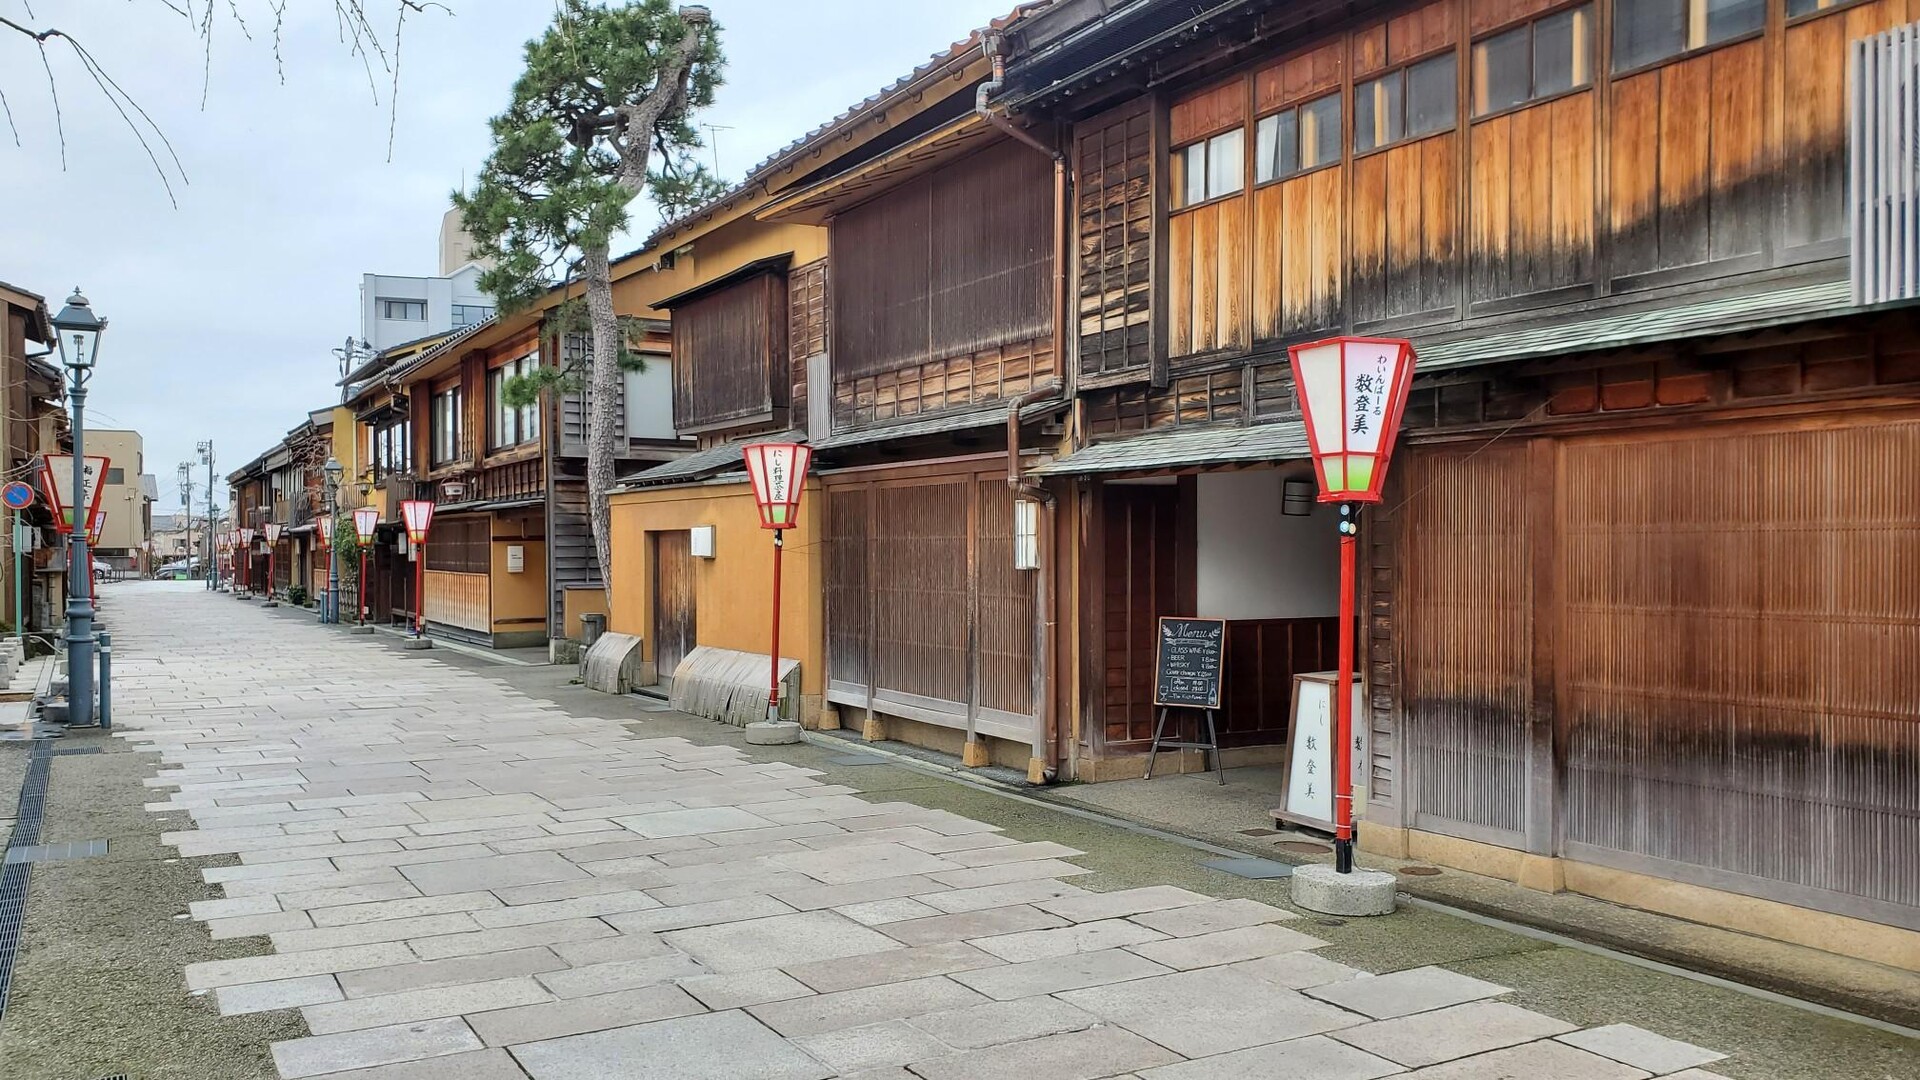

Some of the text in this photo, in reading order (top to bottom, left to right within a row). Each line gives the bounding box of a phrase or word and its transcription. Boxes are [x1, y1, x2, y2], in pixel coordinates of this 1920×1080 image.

[1351, 373, 1374, 435] 数登美
[1373, 354, 1387, 416] わいんばーる
[1172, 623, 1208, 638] Menu
